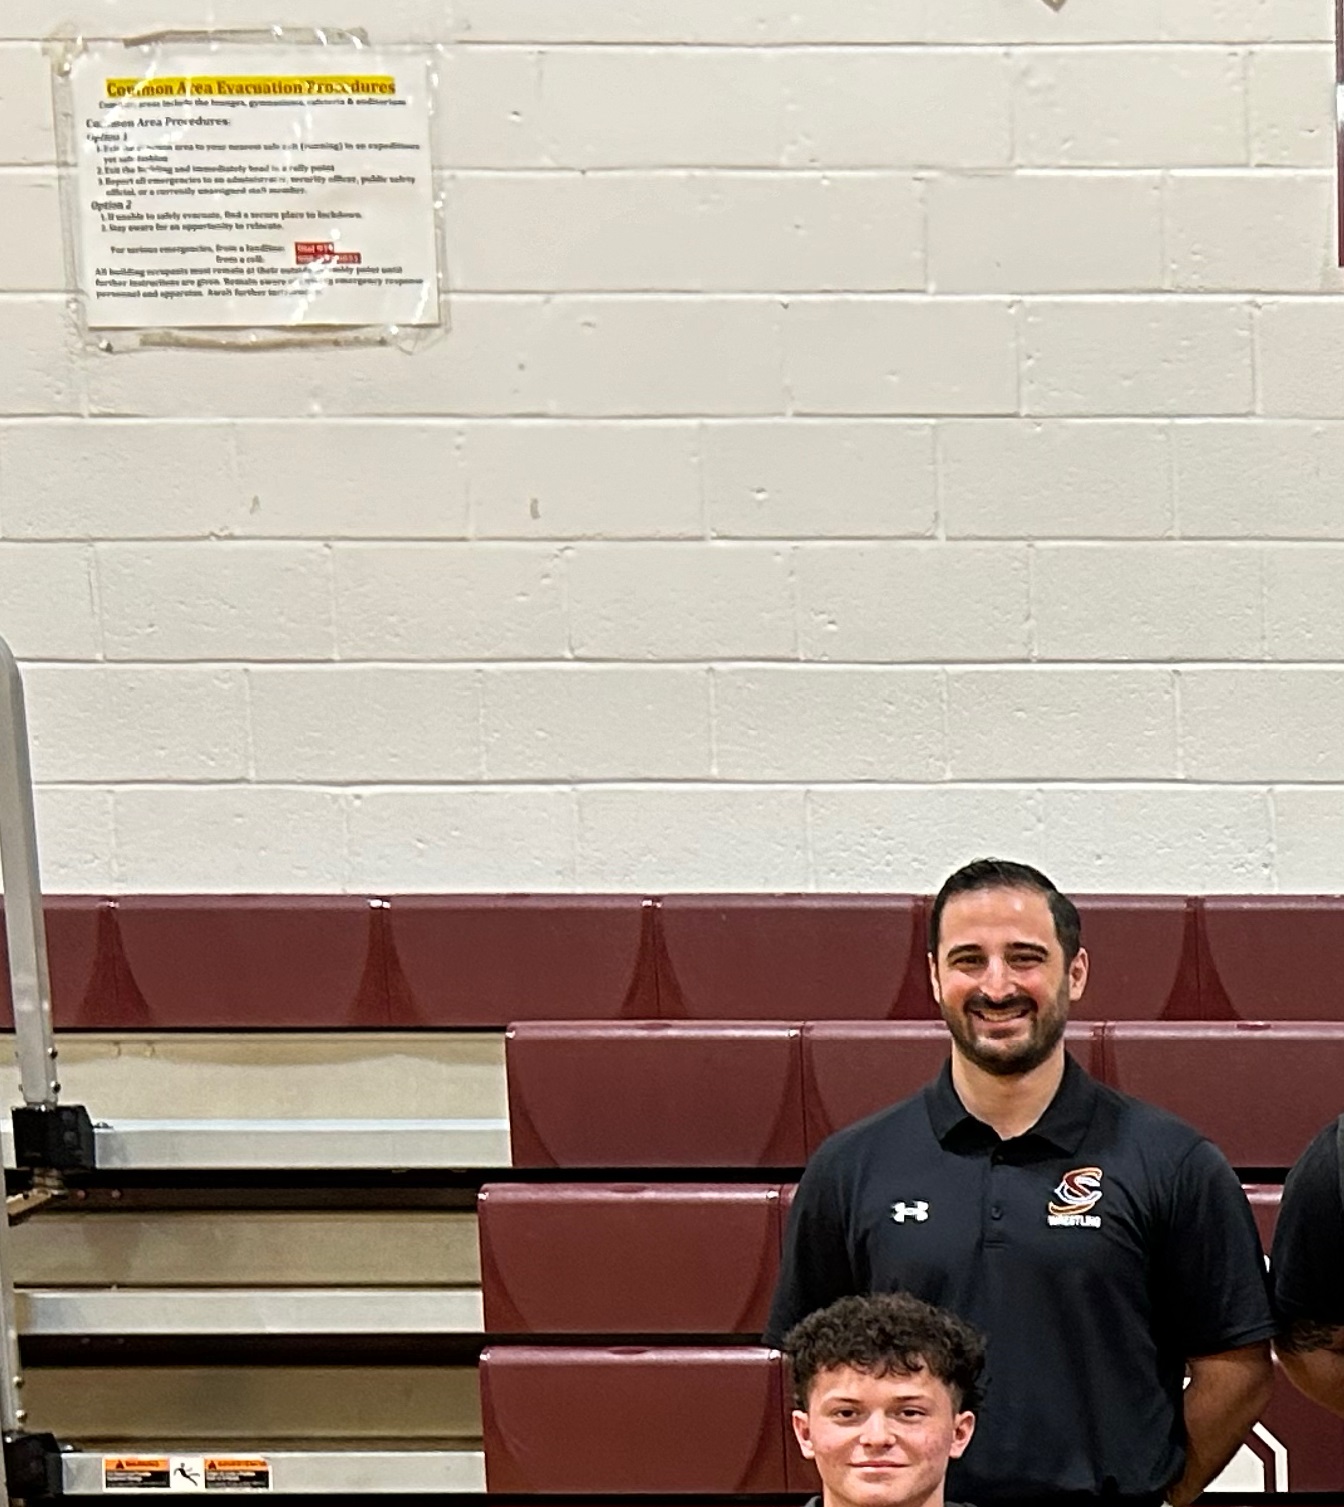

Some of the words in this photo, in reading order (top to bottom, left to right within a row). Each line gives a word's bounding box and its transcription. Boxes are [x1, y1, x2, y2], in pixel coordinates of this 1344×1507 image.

[216, 79, 303, 95] Evacuation
[137, 118, 162, 127] Area
[91, 200, 124, 211] Option
